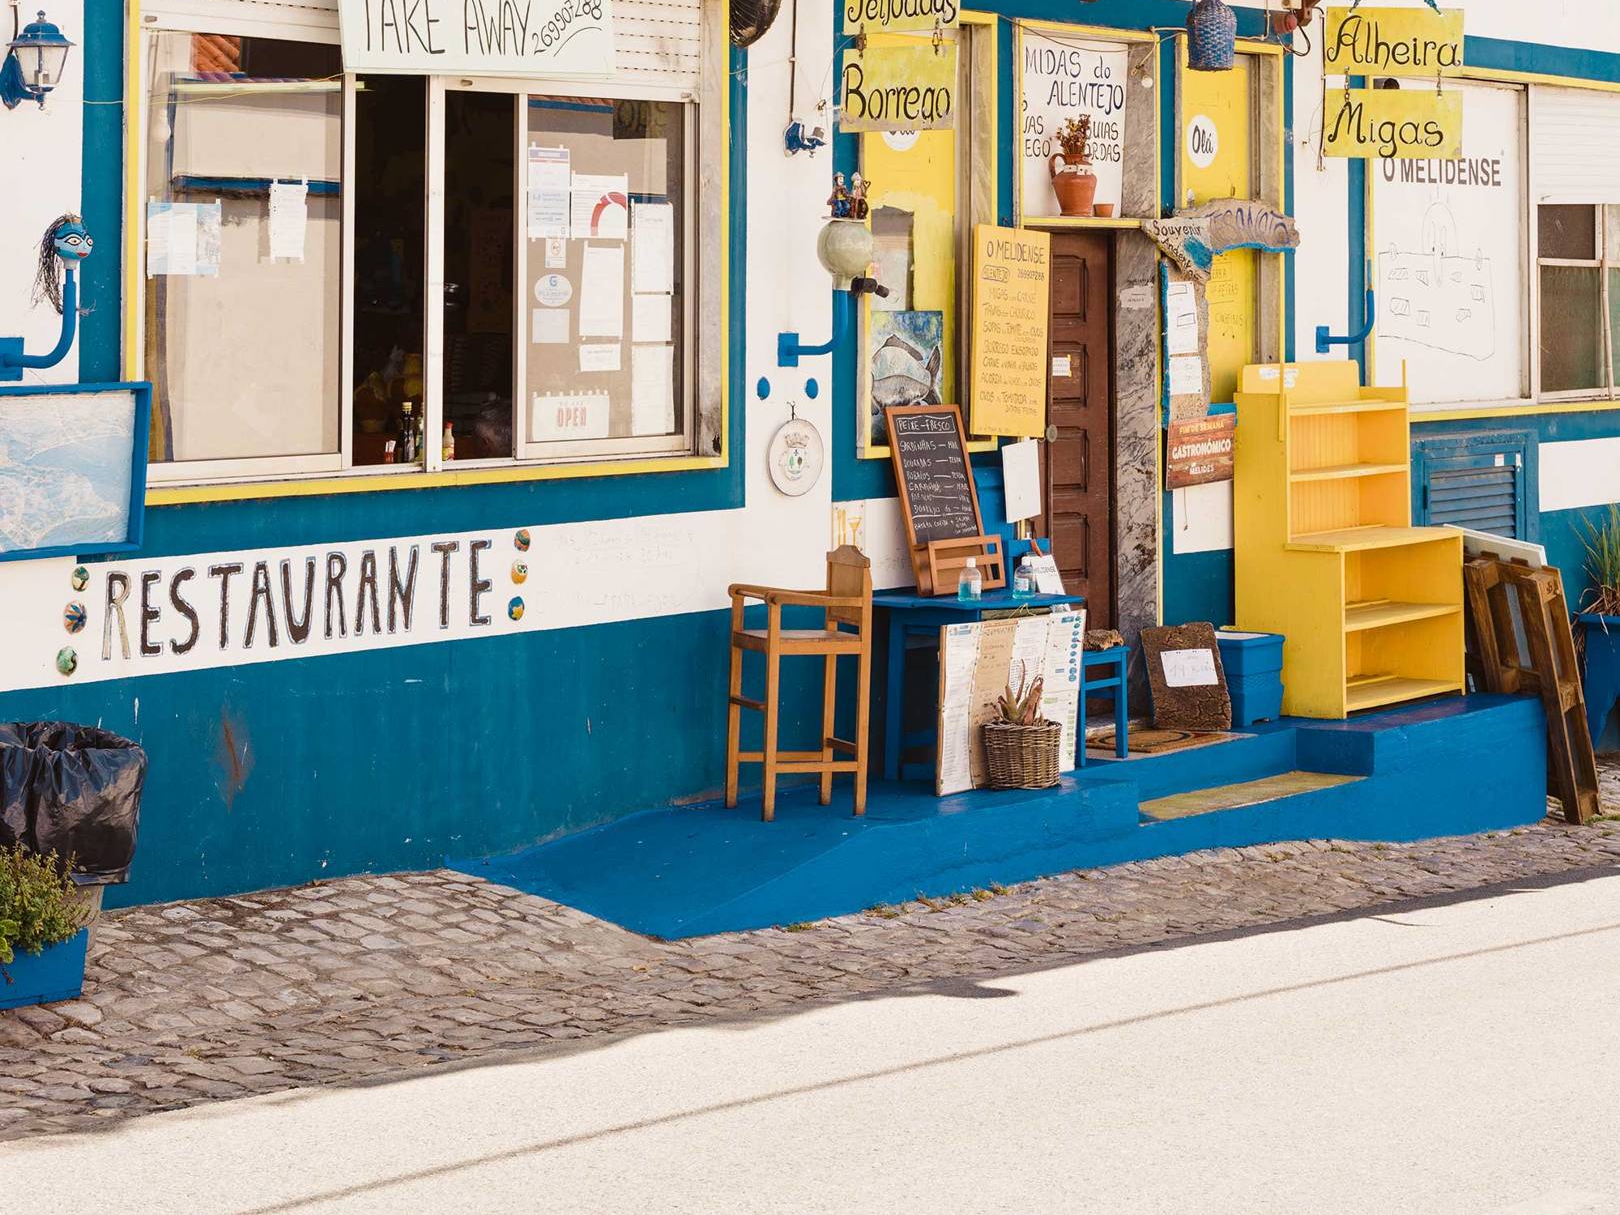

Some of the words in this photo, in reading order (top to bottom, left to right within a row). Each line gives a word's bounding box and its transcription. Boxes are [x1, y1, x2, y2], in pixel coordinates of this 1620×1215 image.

[1326, 14, 1462, 71] Alheira
[1093, 54, 1112, 80] do
[1046, 79, 1124, 116] ALENTEJO
[1191, 124, 1214, 154] Olá
[1327, 101, 1444, 159] Migas
[1382, 156, 1396, 183] O
[1400, 158, 1502, 187] MELIDENSE
[986, 240, 994, 258] O
[1171, 439, 1232, 460] GASTRONÓMICO
[101, 539, 492, 662] RESTAURANTE
